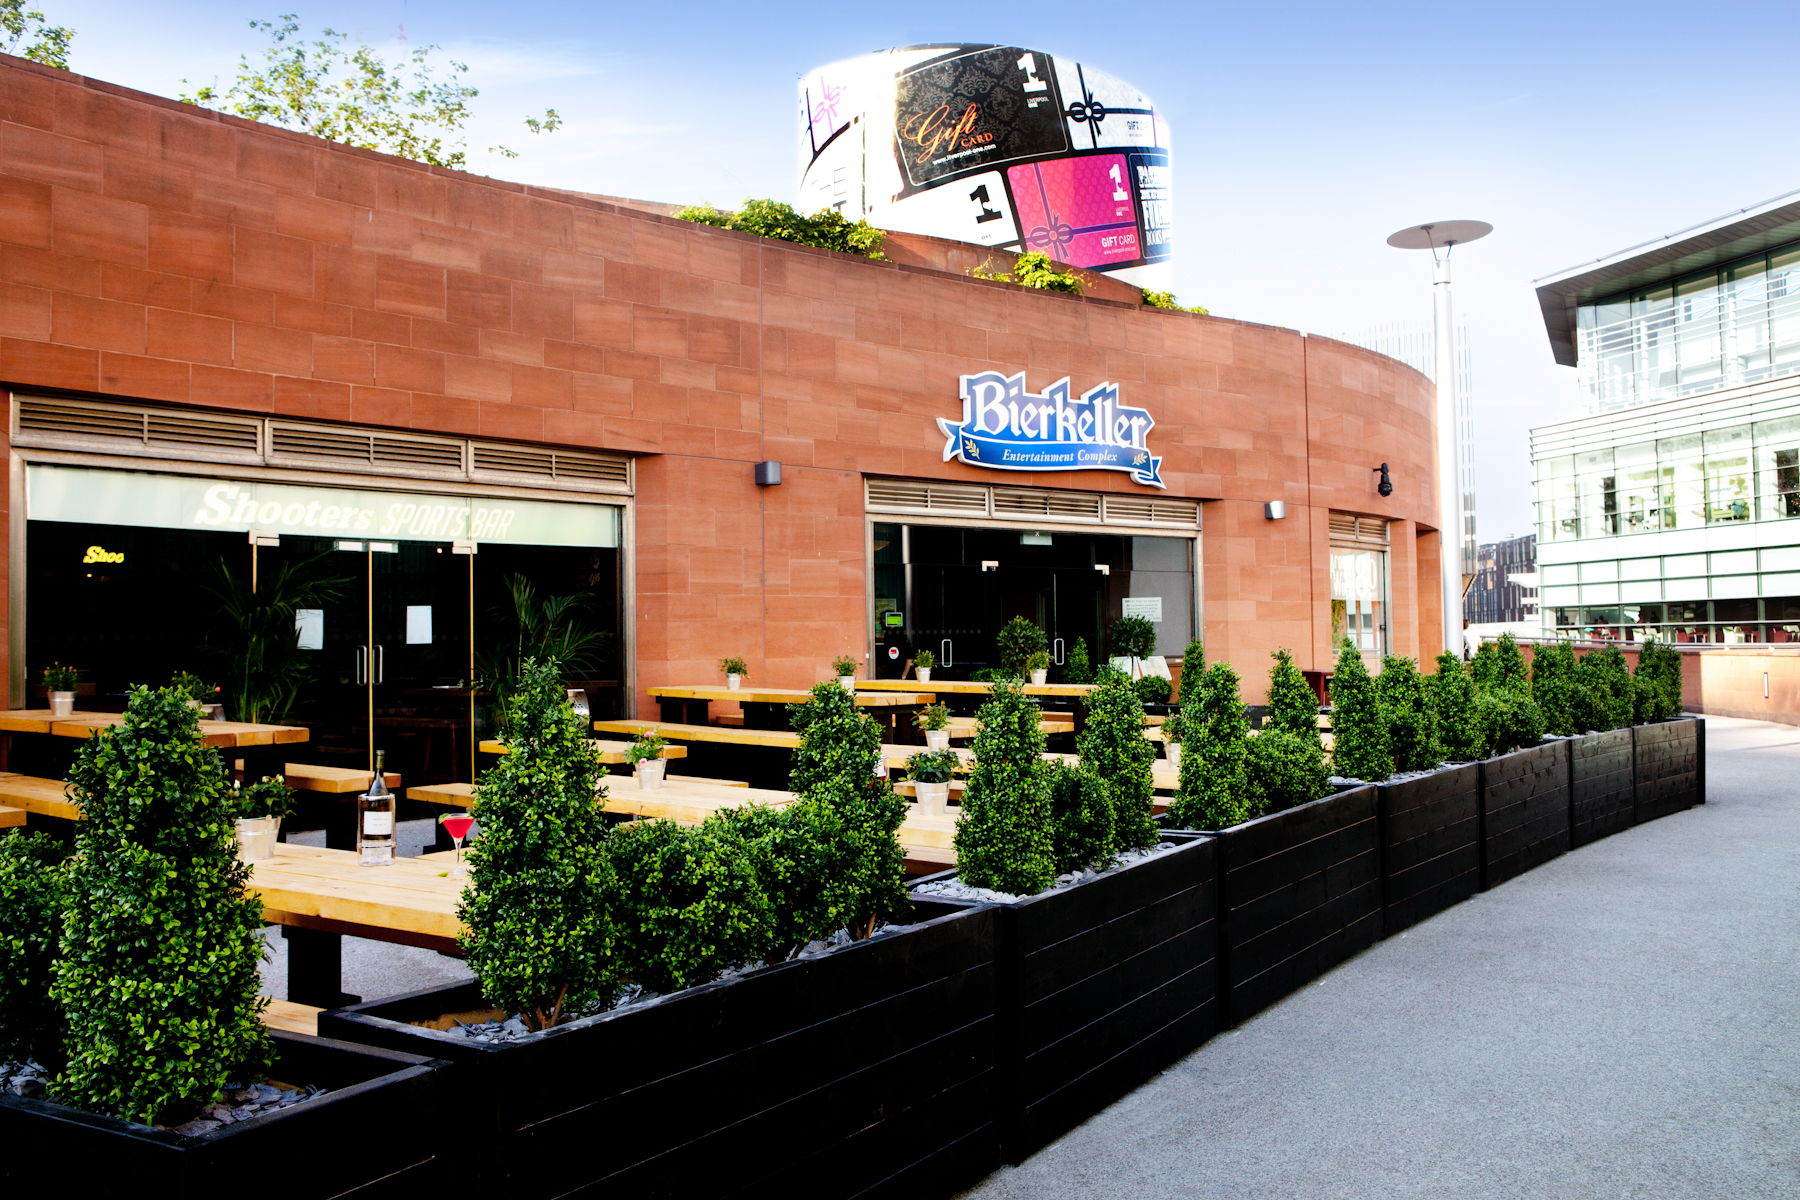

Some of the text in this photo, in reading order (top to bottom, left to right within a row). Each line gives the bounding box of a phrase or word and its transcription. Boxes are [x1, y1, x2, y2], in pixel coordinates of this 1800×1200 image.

[904, 103, 977, 164] Gift
[961, 132, 994, 147] CARD
[932, 143, 996, 165] www.liverpool-one.com
[1101, 234, 1135, 248] GIFT CARD
[972, 381, 1147, 449] Bierkeller
[1002, 449, 1118, 464] Entertainment Complex
[193, 484, 515, 539] Shooters SPORTS BAR
